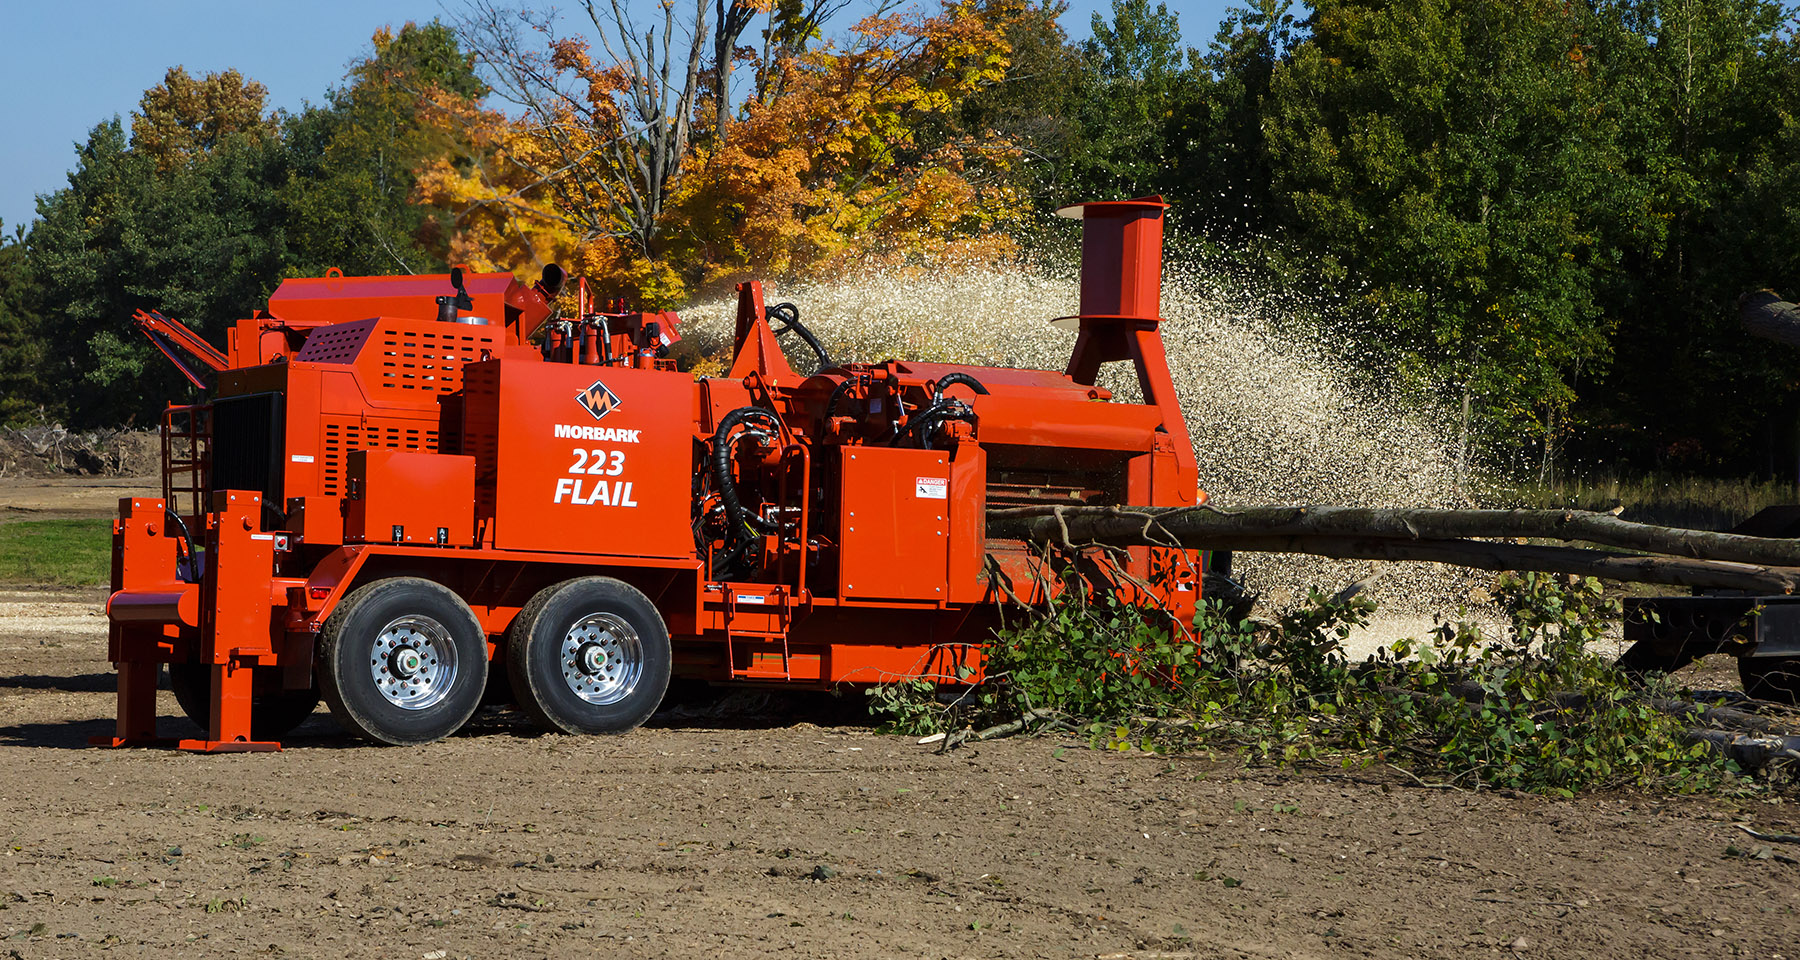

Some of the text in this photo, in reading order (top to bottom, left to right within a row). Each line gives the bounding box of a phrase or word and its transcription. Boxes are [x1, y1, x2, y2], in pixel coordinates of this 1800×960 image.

[554, 424, 640, 443] MORBARK
[568, 448, 625, 476] 223
[553, 478, 638, 507] FLAIL
